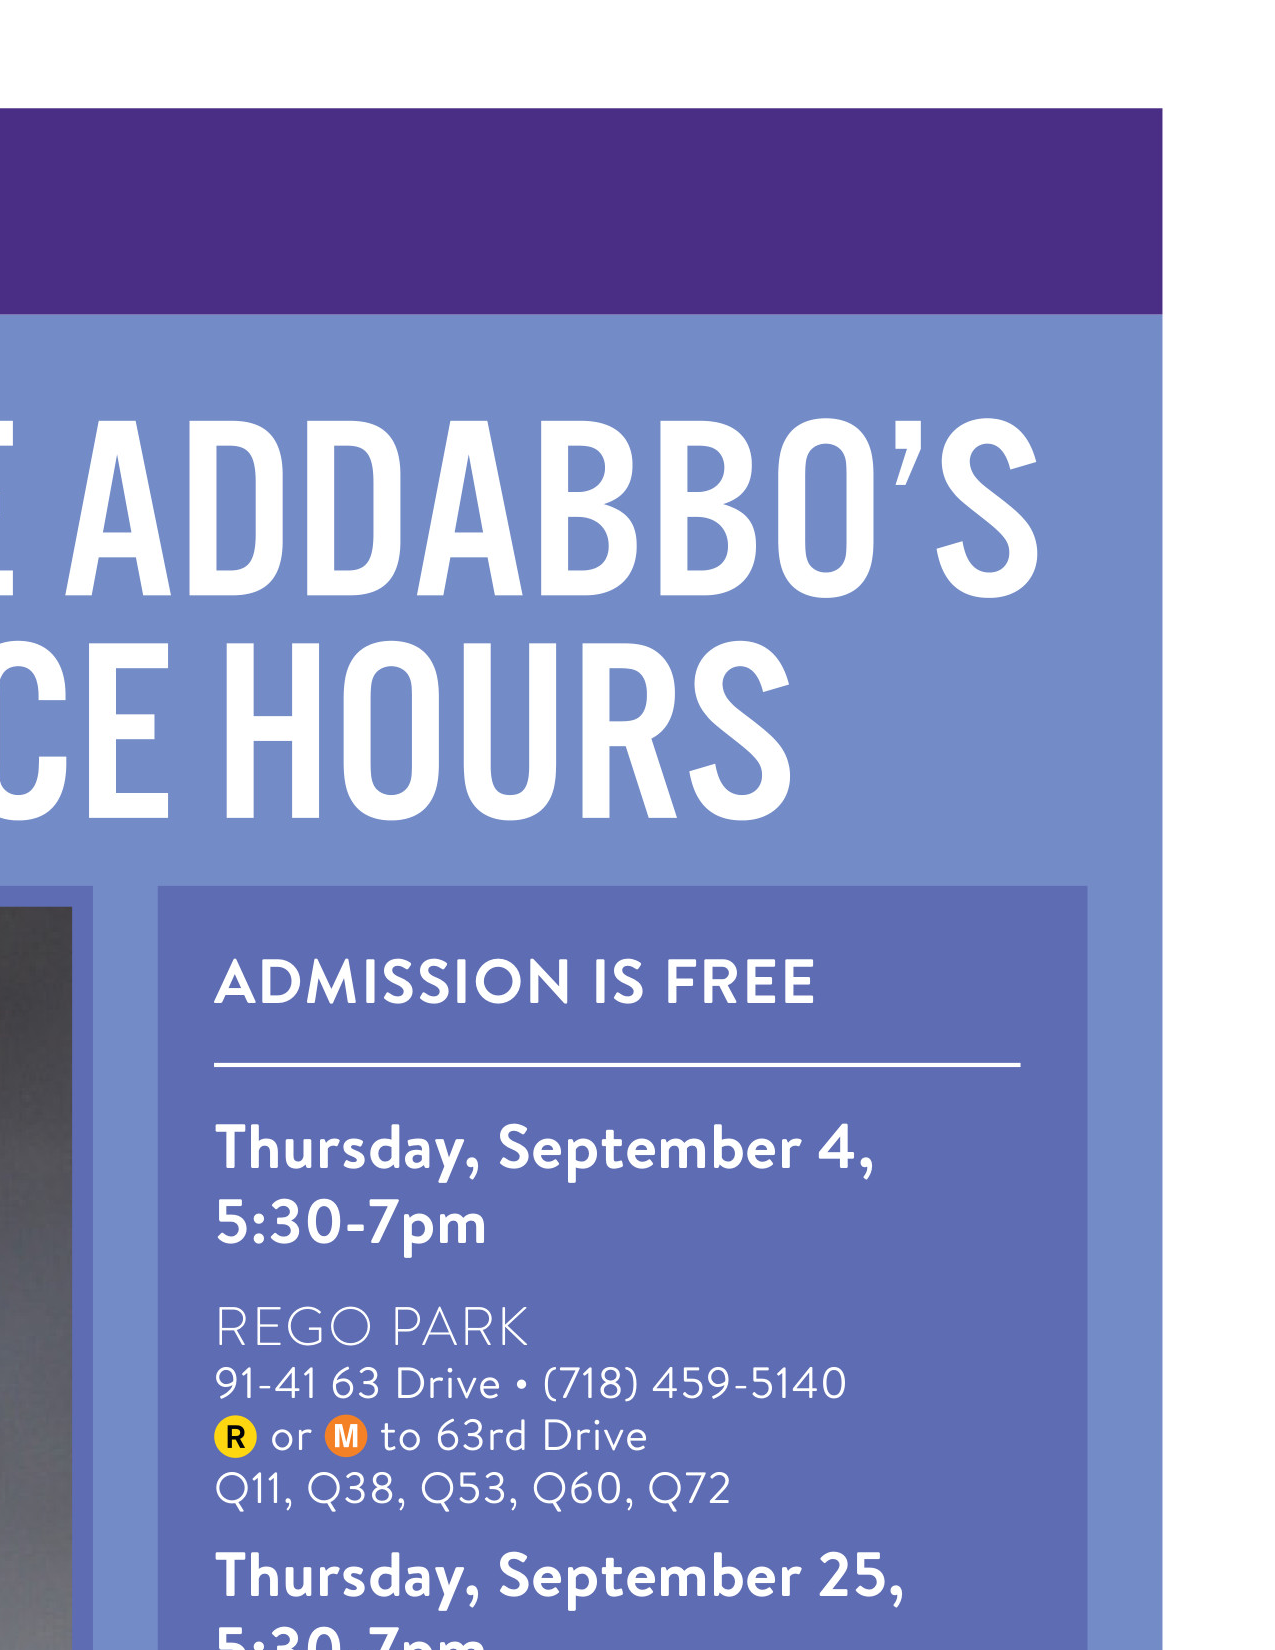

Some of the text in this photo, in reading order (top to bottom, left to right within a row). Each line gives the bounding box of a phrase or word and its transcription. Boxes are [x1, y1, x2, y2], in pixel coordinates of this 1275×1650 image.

[227, 641, 790, 821] HOURS
[214, 958, 813, 1004] ADMISSION IS FREE
[215, 1123, 872, 1183] Thursday, September 4,
[218, 1198, 484, 1258] 5:30-7pm
[219, 1306, 527, 1346] REGO PARK
[216, 1367, 845, 1401] 91-41 63 Drive (718) 459-5140
[438, 1419, 646, 1451] 63rd Drive
[216, 1472, 729, 1512] Q11, Q38, Q53, Q60, Q72
[215, 1552, 902, 1611] Thursday, September 25,
